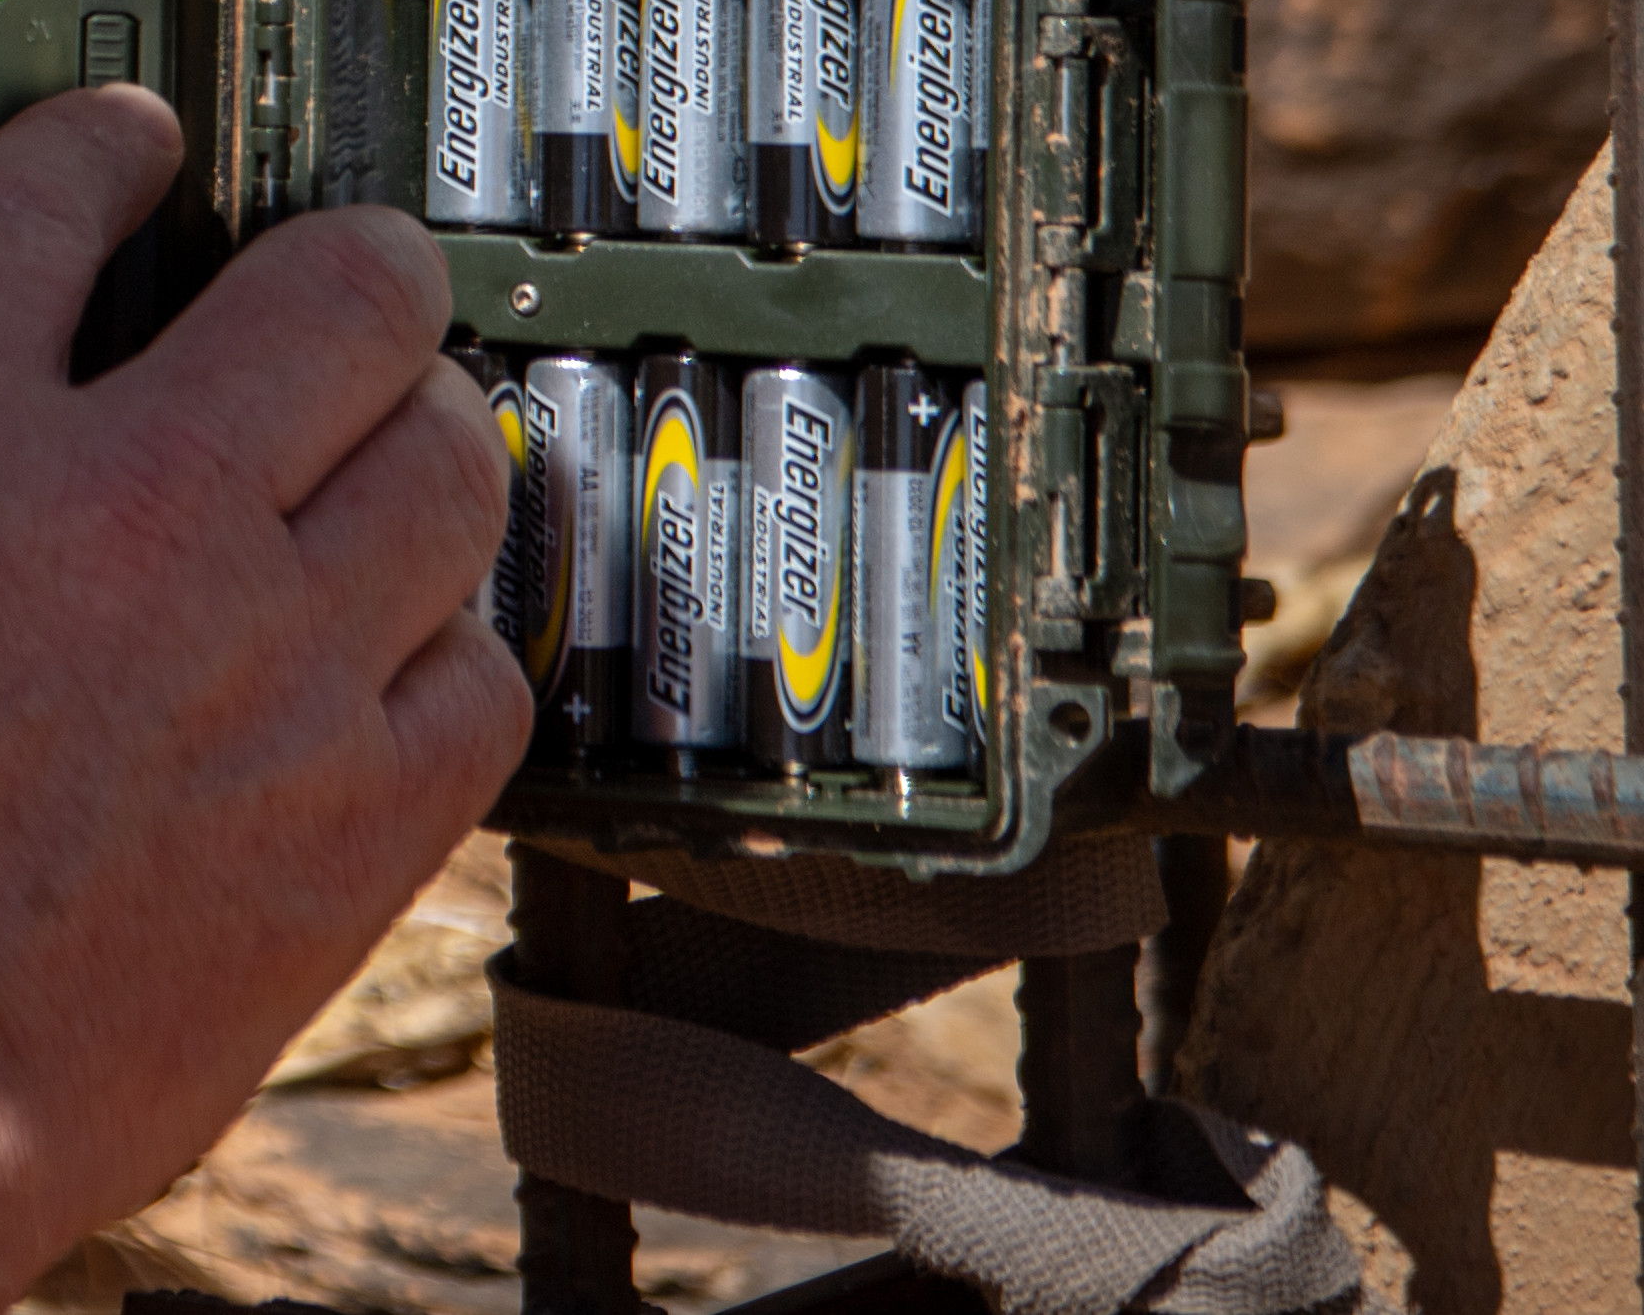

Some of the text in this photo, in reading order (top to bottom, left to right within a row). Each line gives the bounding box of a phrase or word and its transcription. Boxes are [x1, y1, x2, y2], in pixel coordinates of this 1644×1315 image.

[526, 391, 557, 607] Energizer
[581, 467, 599, 493] AA
[709, 482, 725, 625] INDUSTRIAL
[776, 401, 831, 625] Energizer
[647, 493, 704, 715] Energizer
[753, 491, 769, 638] INDUSTRIAL
[901, 631, 922, 659] AA
